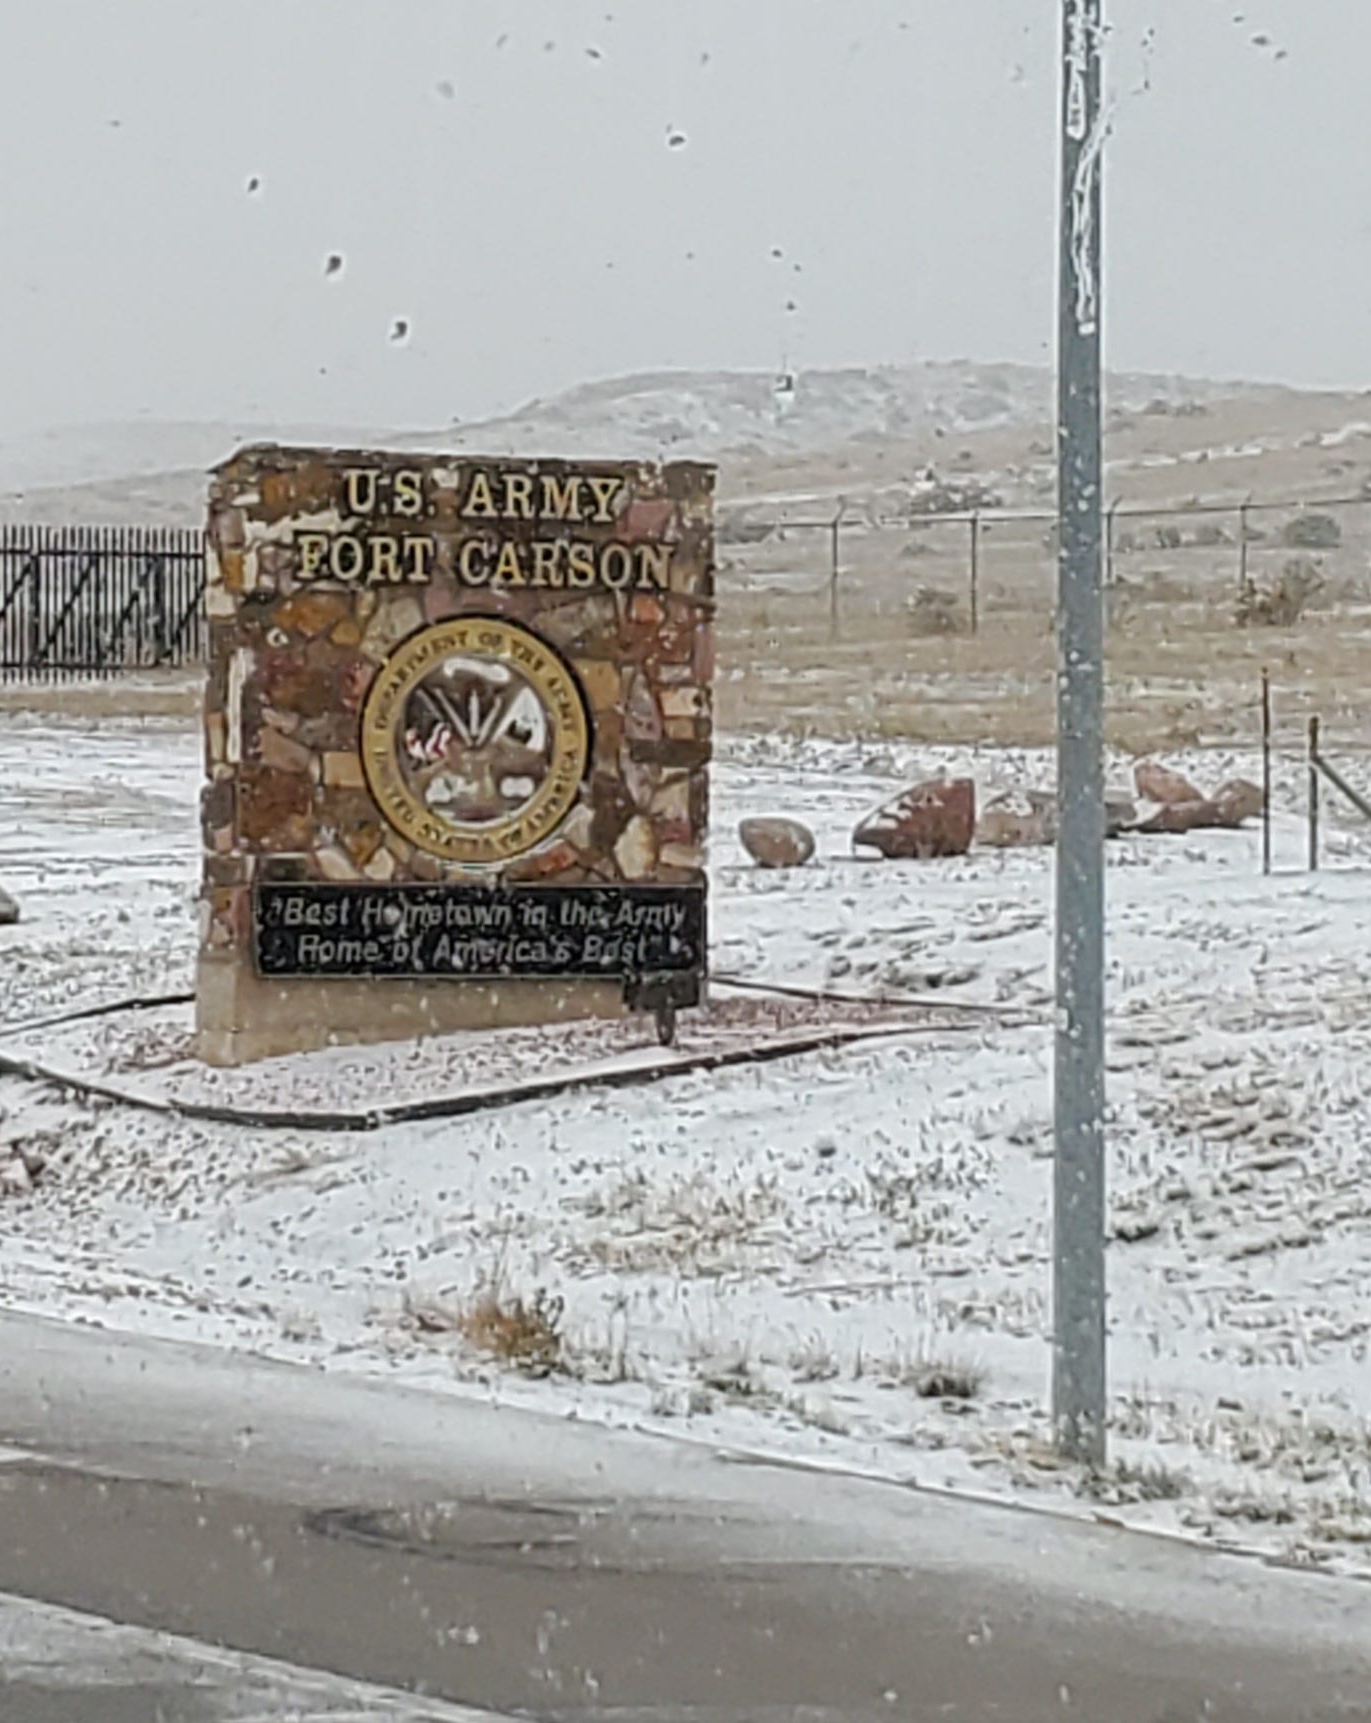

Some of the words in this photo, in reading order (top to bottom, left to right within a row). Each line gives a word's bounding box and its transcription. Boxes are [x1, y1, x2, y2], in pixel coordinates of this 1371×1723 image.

[345, 469, 436, 516] U.S.
[461, 473, 622, 522] ARMY
[296, 534, 435, 583] FORT
[460, 539, 674, 590] CARSON
[360, 896, 513, 929] Hmetown
[297, 933, 382, 964] Home
